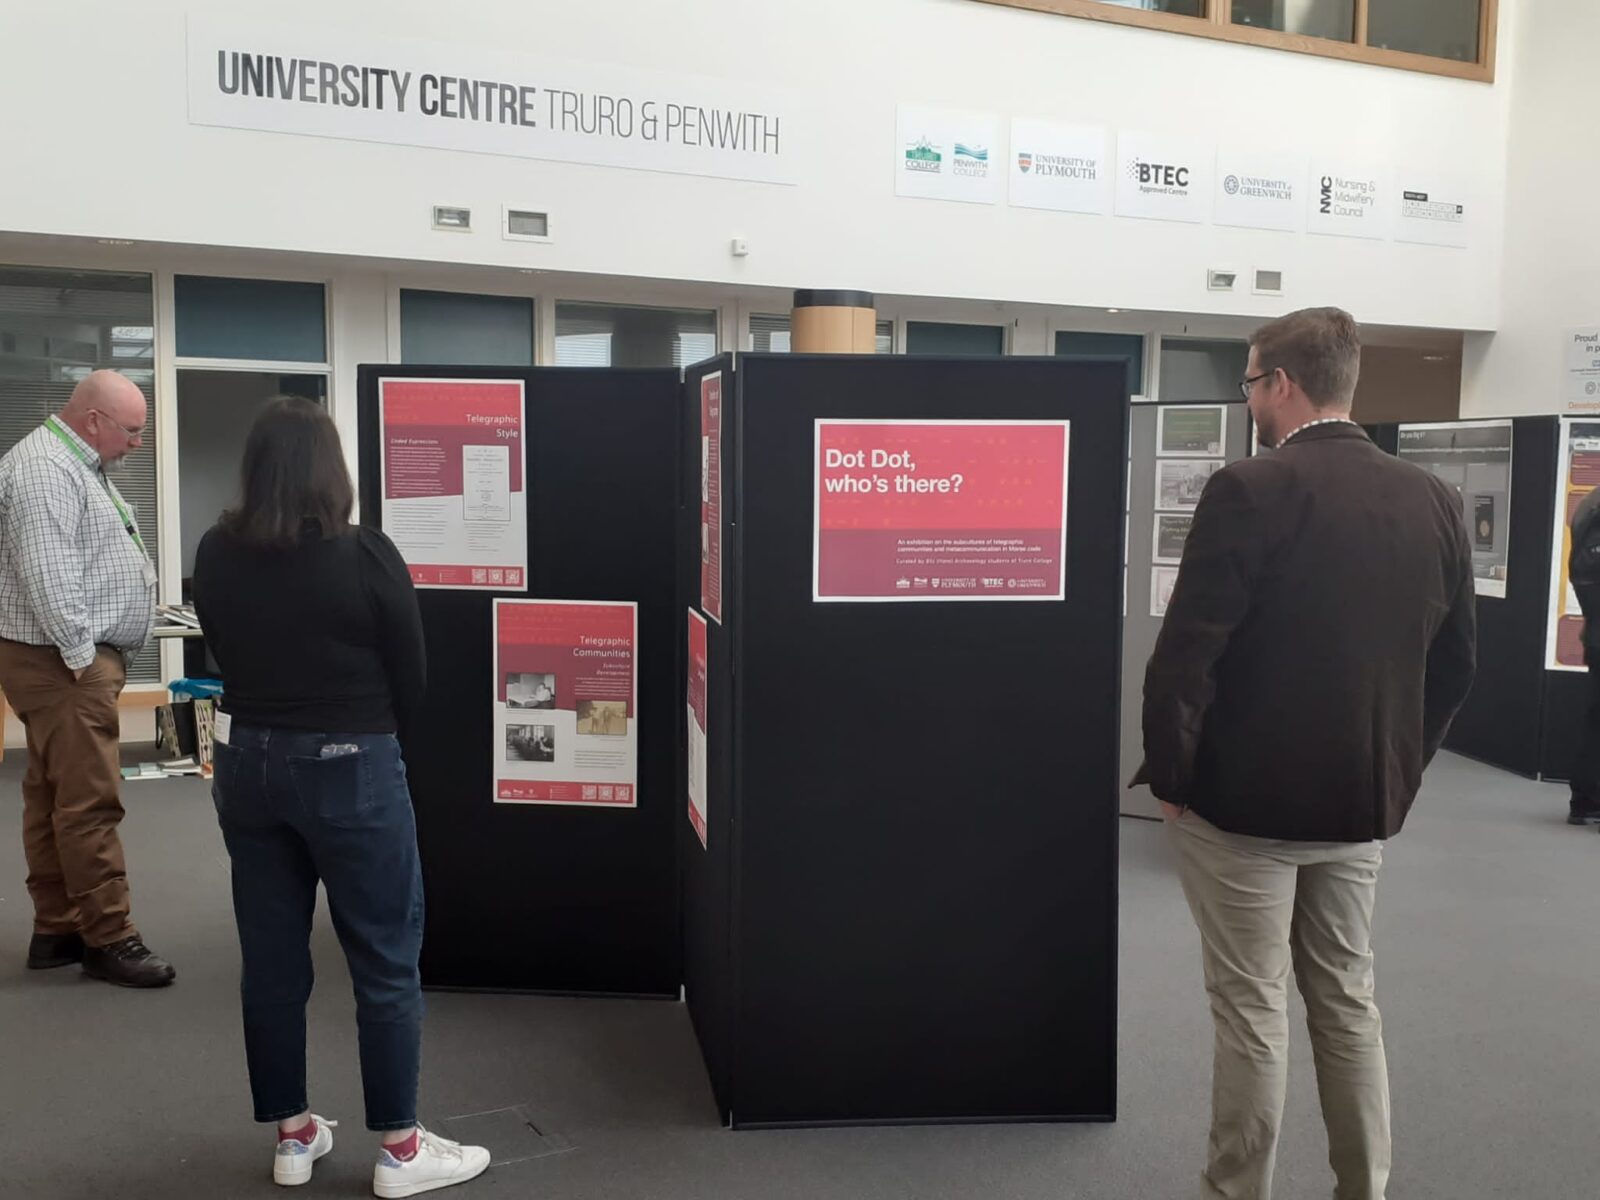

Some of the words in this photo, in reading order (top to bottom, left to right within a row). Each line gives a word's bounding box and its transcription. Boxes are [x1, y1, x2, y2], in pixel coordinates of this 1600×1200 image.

[218, 50, 411, 113] UNIVERSITY
[419, 73, 536, 128] CENTRE
[543, 88, 633, 138] TRURO
[641, 101, 658, 141] &
[666, 103, 779, 154] PENWITH
[905, 160, 941, 170] COLLEGE
[953, 158, 988, 170] PENWITH
[1035, 154, 1085, 167] UNIVERSITY
[1087, 159, 1096, 168] OF
[953, 167, 987, 178] COLLEGE
[1035, 165, 1096, 180] PLYMOUTH
[1139, 163, 1189, 187] BTEC
[1241, 177, 1287, 190] UNIVERSITY
[1335, 177, 1367, 193] Nursing
[1368, 181, 1376, 192] &
[1139, 185, 1167, 195] Approved
[1168, 187, 1188, 196] Centre
[1240, 188, 1292, 201] GREENWICH
[1320, 176, 1332, 214] NMC
[1334, 192, 1375, 206] Midwifery
[1334, 205, 1363, 218] Council
[1574, 333, 1598, 343] Proud
[1586, 344, 1594, 352] in
[466, 414, 518, 425] Telegraphic
[496, 429, 518, 439] Style
[825, 449, 865, 468] Dot
[871, 449, 916, 471] Dot,
[825, 474, 888, 493] who's
[894, 473, 963, 493] there?
[984, 578, 1004, 586] BTEC
[580, 635, 631, 647] Telegraphic
[573, 648, 631, 658] Communities
